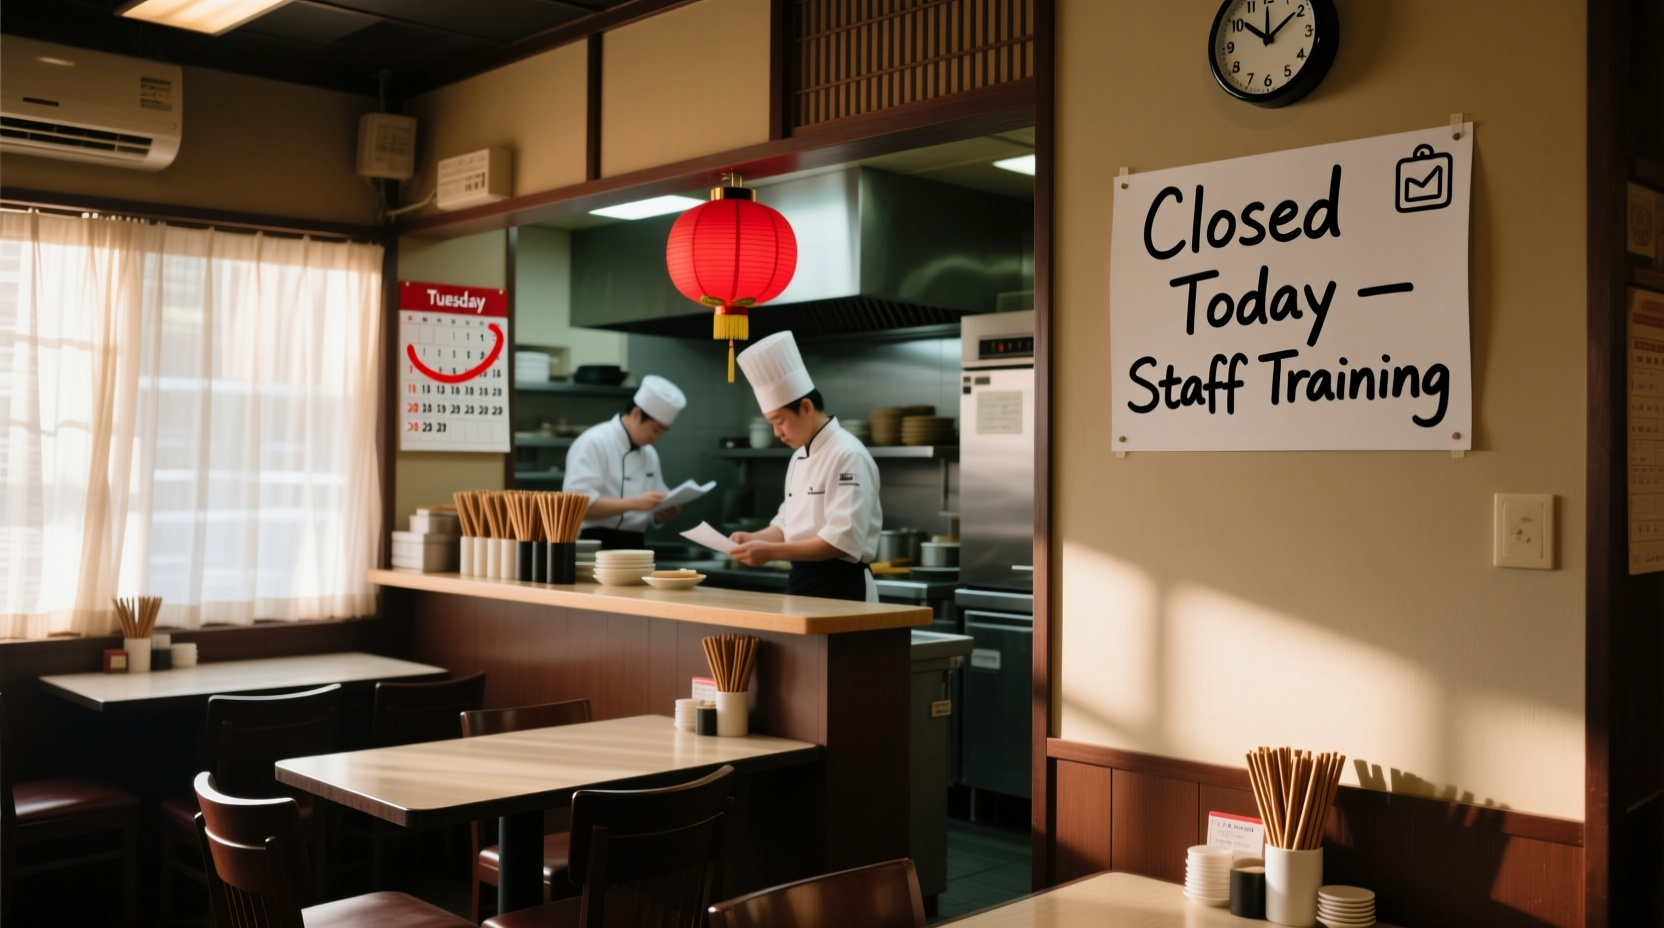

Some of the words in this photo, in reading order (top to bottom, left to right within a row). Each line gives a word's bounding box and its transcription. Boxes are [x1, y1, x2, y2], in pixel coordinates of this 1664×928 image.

[1297, 5, 1305, 17] 2
[1232, 18, 1244, 33] 10
[1305, 24, 1314, 37] 3
[1226, 41, 1235, 54] 9
[1296, 47, 1306, 60] 4
[1232, 61, 1241, 73] 8
[1284, 65, 1292, 77] 5
[1247, 73, 1255, 87] 7
[1264, 74, 1273, 87] 6
[1143, 163, 1342, 260] Closed
[426, 288, 486, 314] Tuesday
[1169, 264, 1337, 348] Today
[1127, 352, 1249, 415] Staff
[1258, 348, 1450, 428] Training
